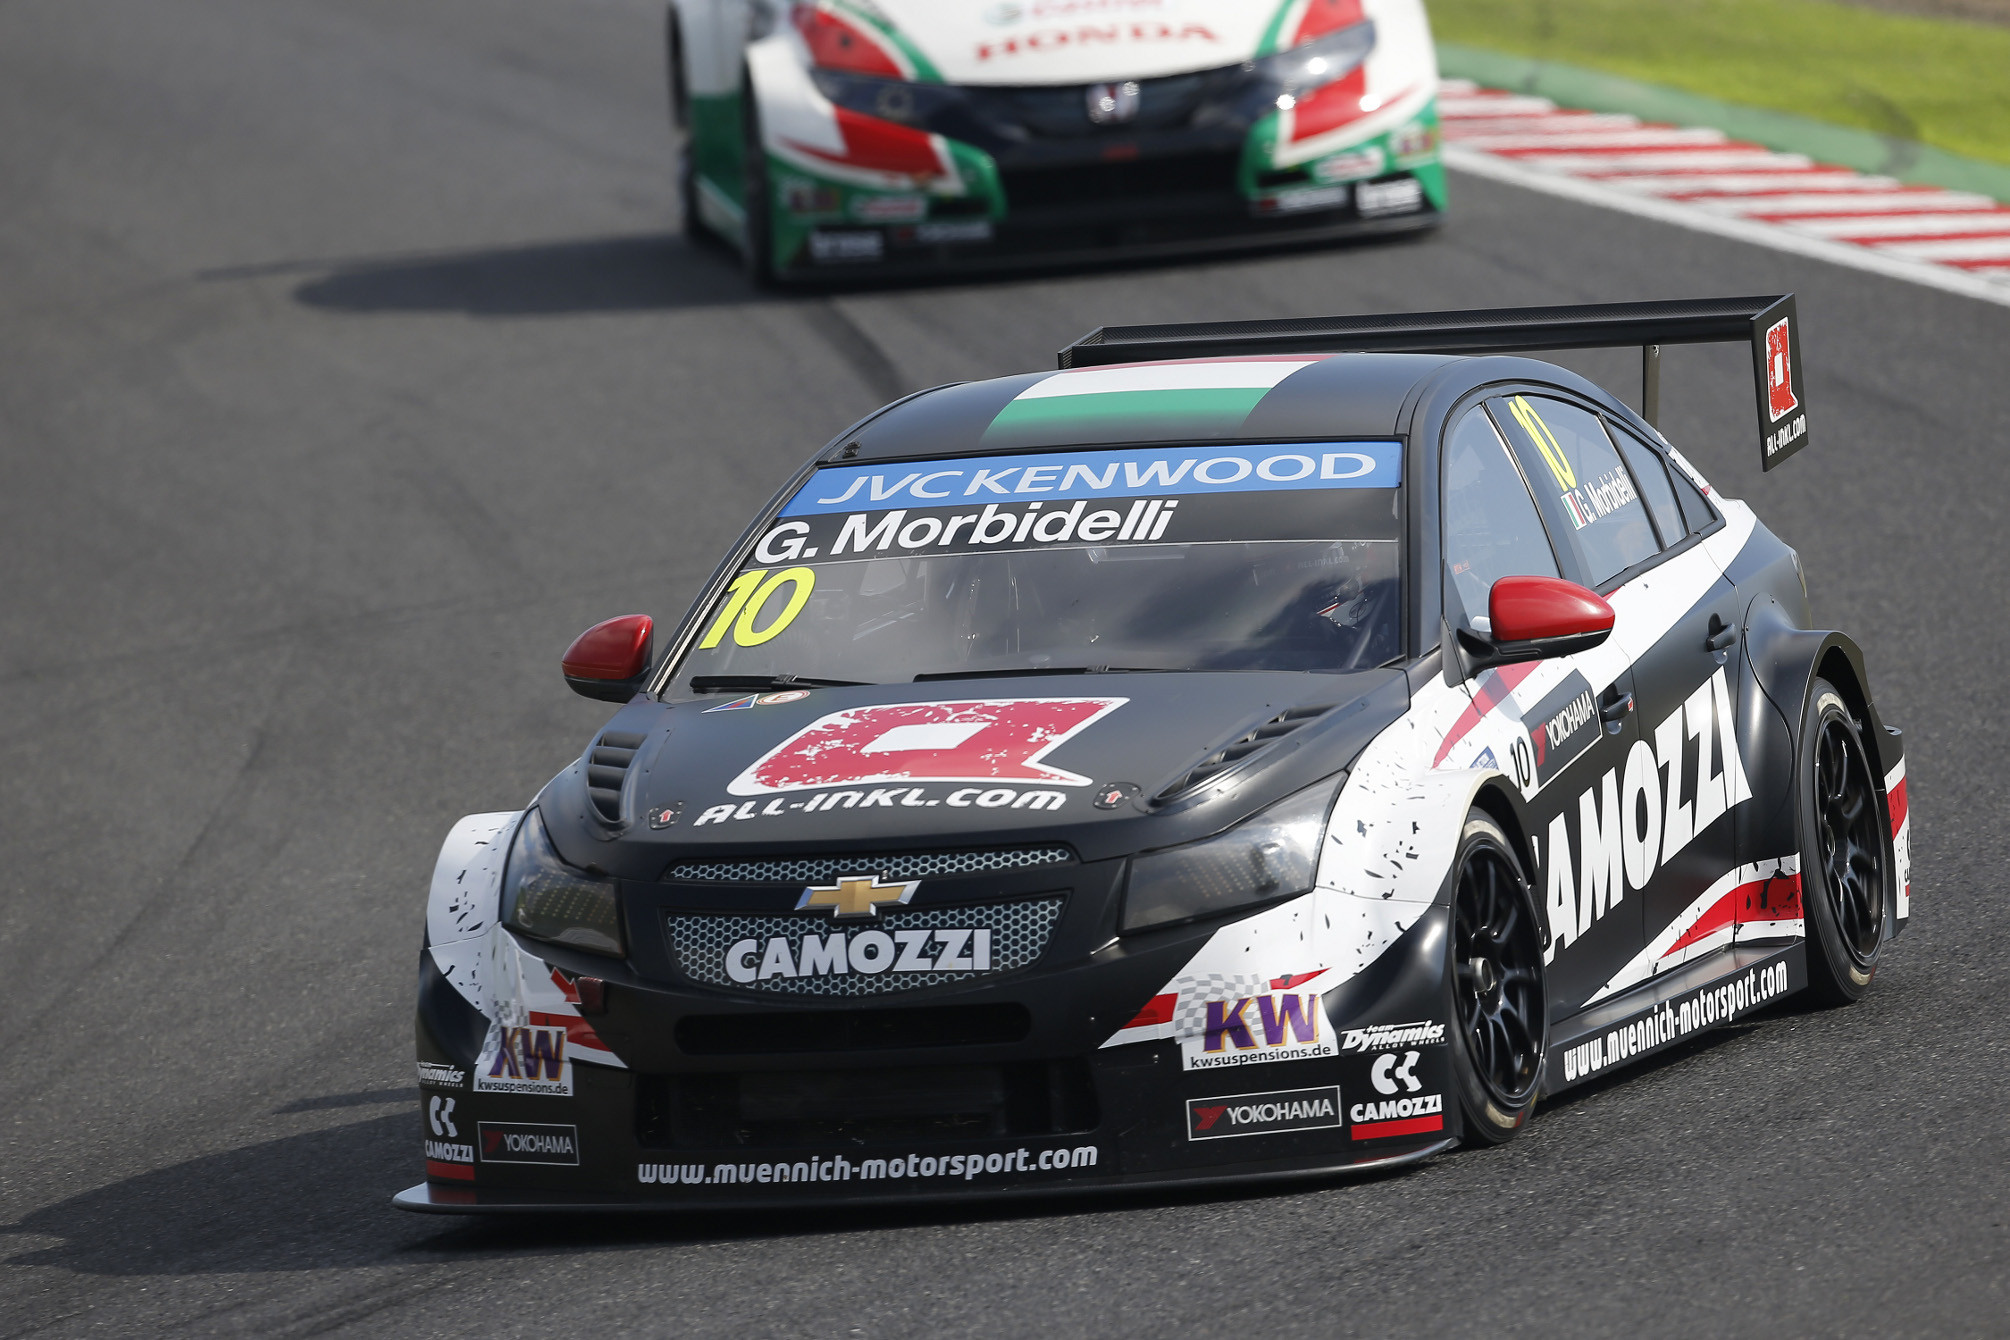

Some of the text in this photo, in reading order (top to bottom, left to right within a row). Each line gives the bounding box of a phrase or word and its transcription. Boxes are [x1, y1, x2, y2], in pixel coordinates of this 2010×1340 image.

[973, 22, 1226, 64] HONDA
[1508, 395, 1577, 492] 10
[754, 499, 1179, 565] G. Morbidelli
[698, 567, 816, 650] 10
[1545, 690, 1596, 750] YOKOHAMA
[1510, 736, 1531, 793] 10
[1531, 665, 1753, 968] AMOZZI
[725, 928, 991, 984] CAMOZZI
[1203, 993, 1321, 1054] KW
[1340, 1019, 1445, 1053] Dynamics
[1563, 960, 1788, 1082] www.muennich-motorsport.com
[488, 1026, 567, 1082] KW
[1190, 1044, 1331, 1068] kwsuspensions.de
[477, 1079, 568, 1095] kwsuspensions.de
[1227, 1098, 1335, 1125] YOKOHAMA
[1350, 1094, 1442, 1123] CAMOZZI
[503, 1133, 574, 1154] YOKOHAMA
[637, 1145, 1098, 1184] www.muennich-motorsport.com
